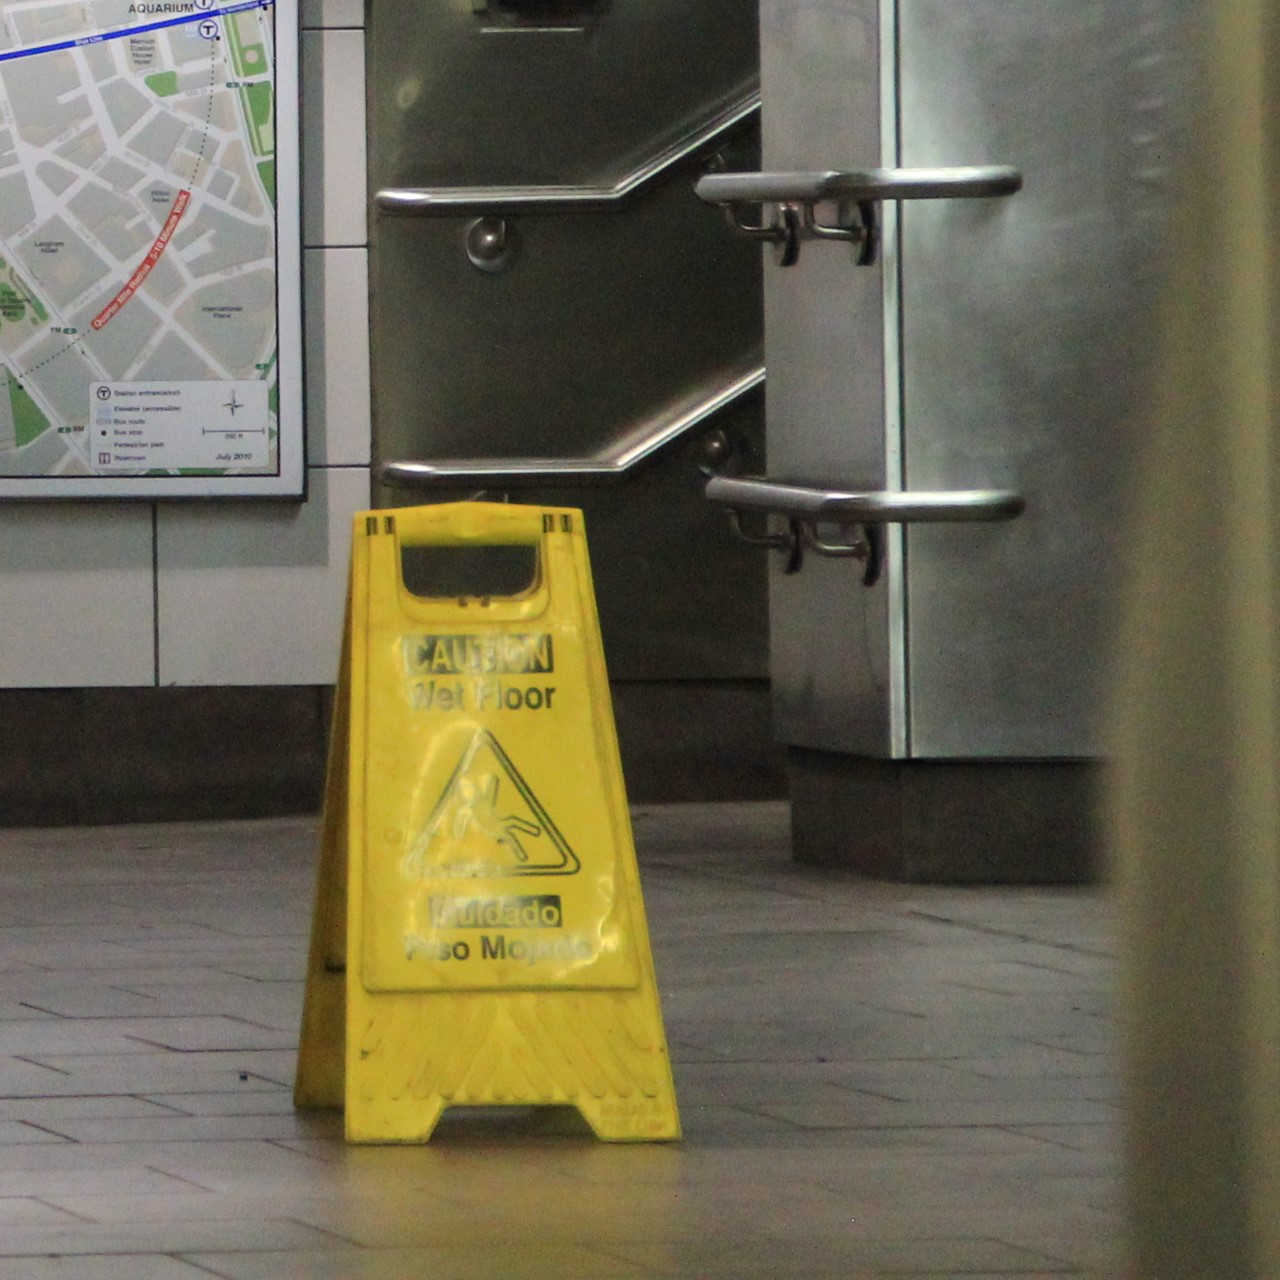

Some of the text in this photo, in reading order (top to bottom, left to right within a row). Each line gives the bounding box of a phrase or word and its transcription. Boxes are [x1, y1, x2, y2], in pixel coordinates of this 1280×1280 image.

[129, 4, 194, 13] AQUARIUM
[94, 302, 117, 327] Quarter
[118, 289, 130, 303] Mile
[150, 243, 164, 258] 5-10
[160, 215, 178, 242] Minute
[174, 195, 187, 213] Walk
[215, 452, 253, 462] July 2010
[407, 635, 550, 672] CAUTION
[409, 679, 556, 711] Wet Floor
